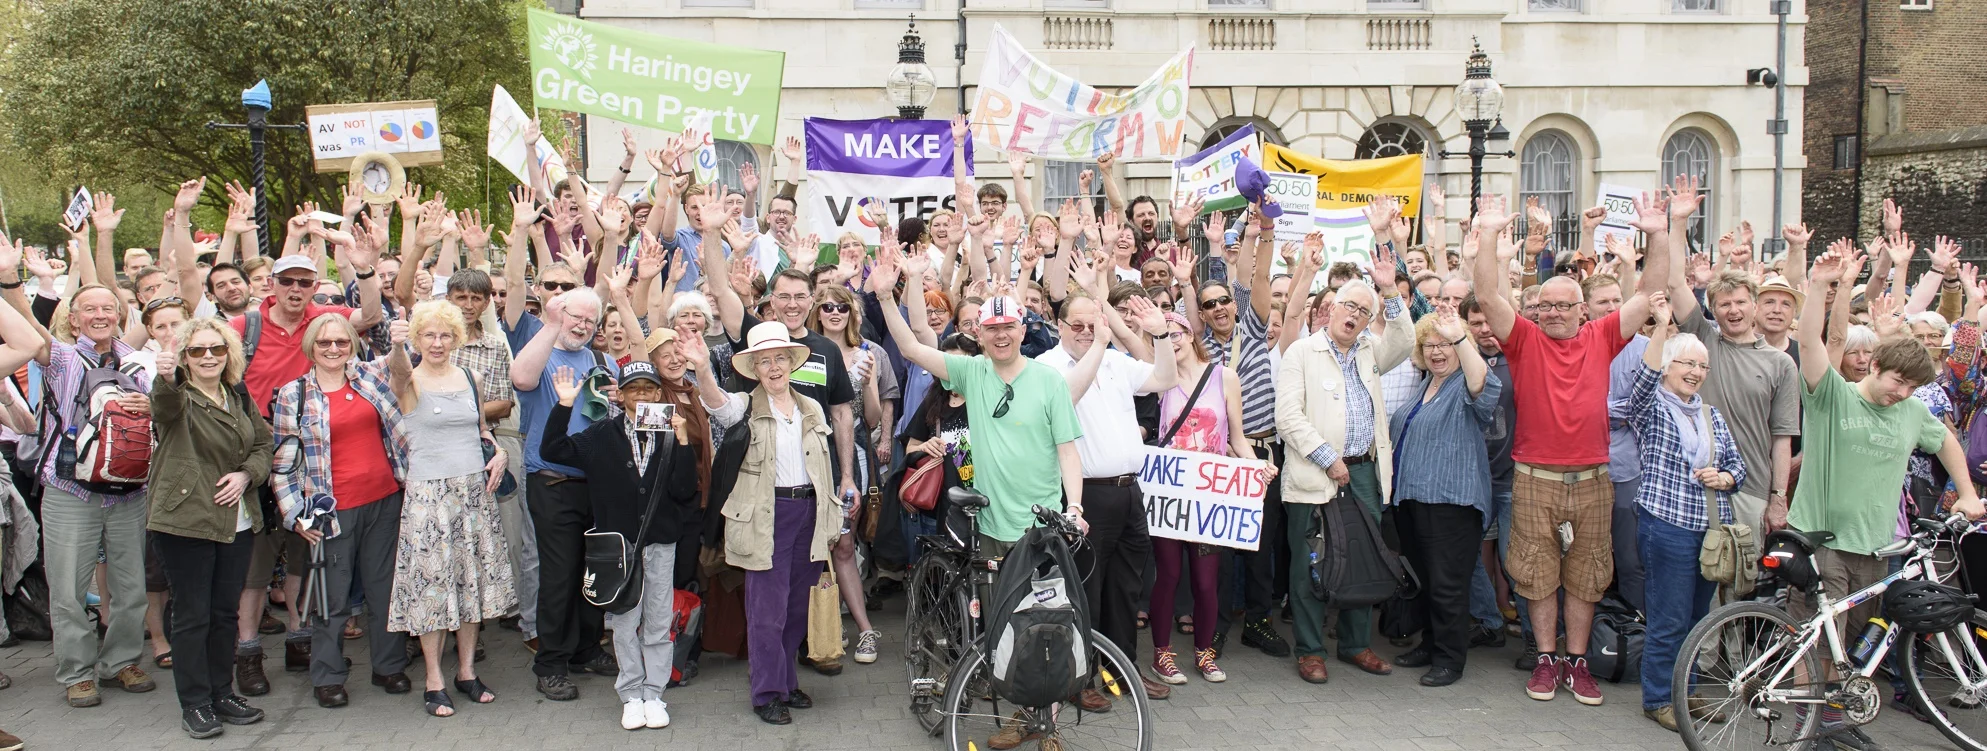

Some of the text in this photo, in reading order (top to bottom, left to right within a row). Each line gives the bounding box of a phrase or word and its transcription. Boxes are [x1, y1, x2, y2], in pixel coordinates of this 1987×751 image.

[608, 45, 752, 97] Haringey
[536, 67, 760, 141] Green Party
[319, 119, 366, 134] AV NOT
[973, 86, 1144, 159] REFORM
[318, 136, 366, 152] was PR
[844, 132, 941, 159] MAKE
[1180, 143, 1251, 183] LOTTERY
[1267, 178, 1312, 198] 50:50
[1604, 198, 1635, 215] 50:50
[1278, 218, 1294, 227] Sign
[623, 361, 654, 374] DIVEST
[1195, 461, 1265, 498] SEATS
[1143, 493, 1262, 544] ATCH VOTES
